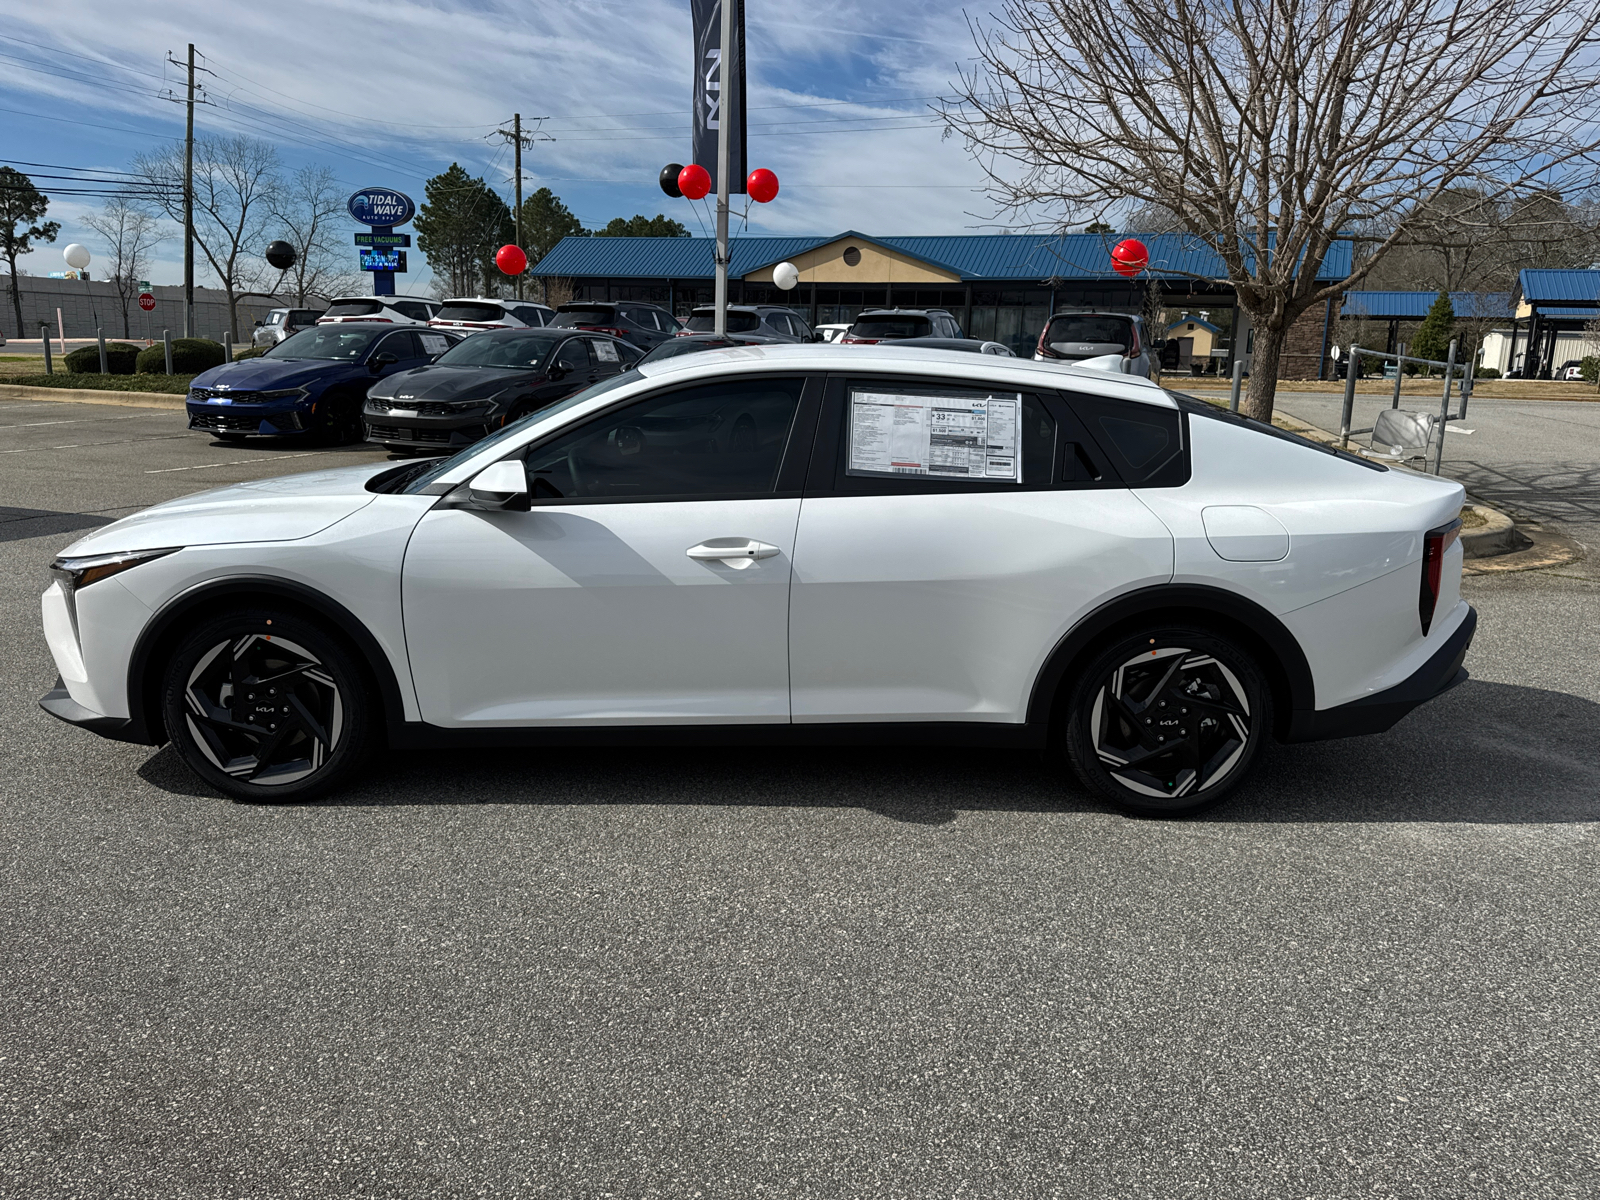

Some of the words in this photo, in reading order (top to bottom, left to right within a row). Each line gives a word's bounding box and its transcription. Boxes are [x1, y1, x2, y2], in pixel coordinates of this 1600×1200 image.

[368, 195, 397, 205] TIDAL
[373, 205, 403, 215] WAVE
[373, 236, 403, 244] VACUUMS
[139, 298, 155, 306] STOP
[935, 413, 946, 421] 33
[166, 659, 184, 707] KUMHO
[1088, 767, 1126, 803] KUMHO
